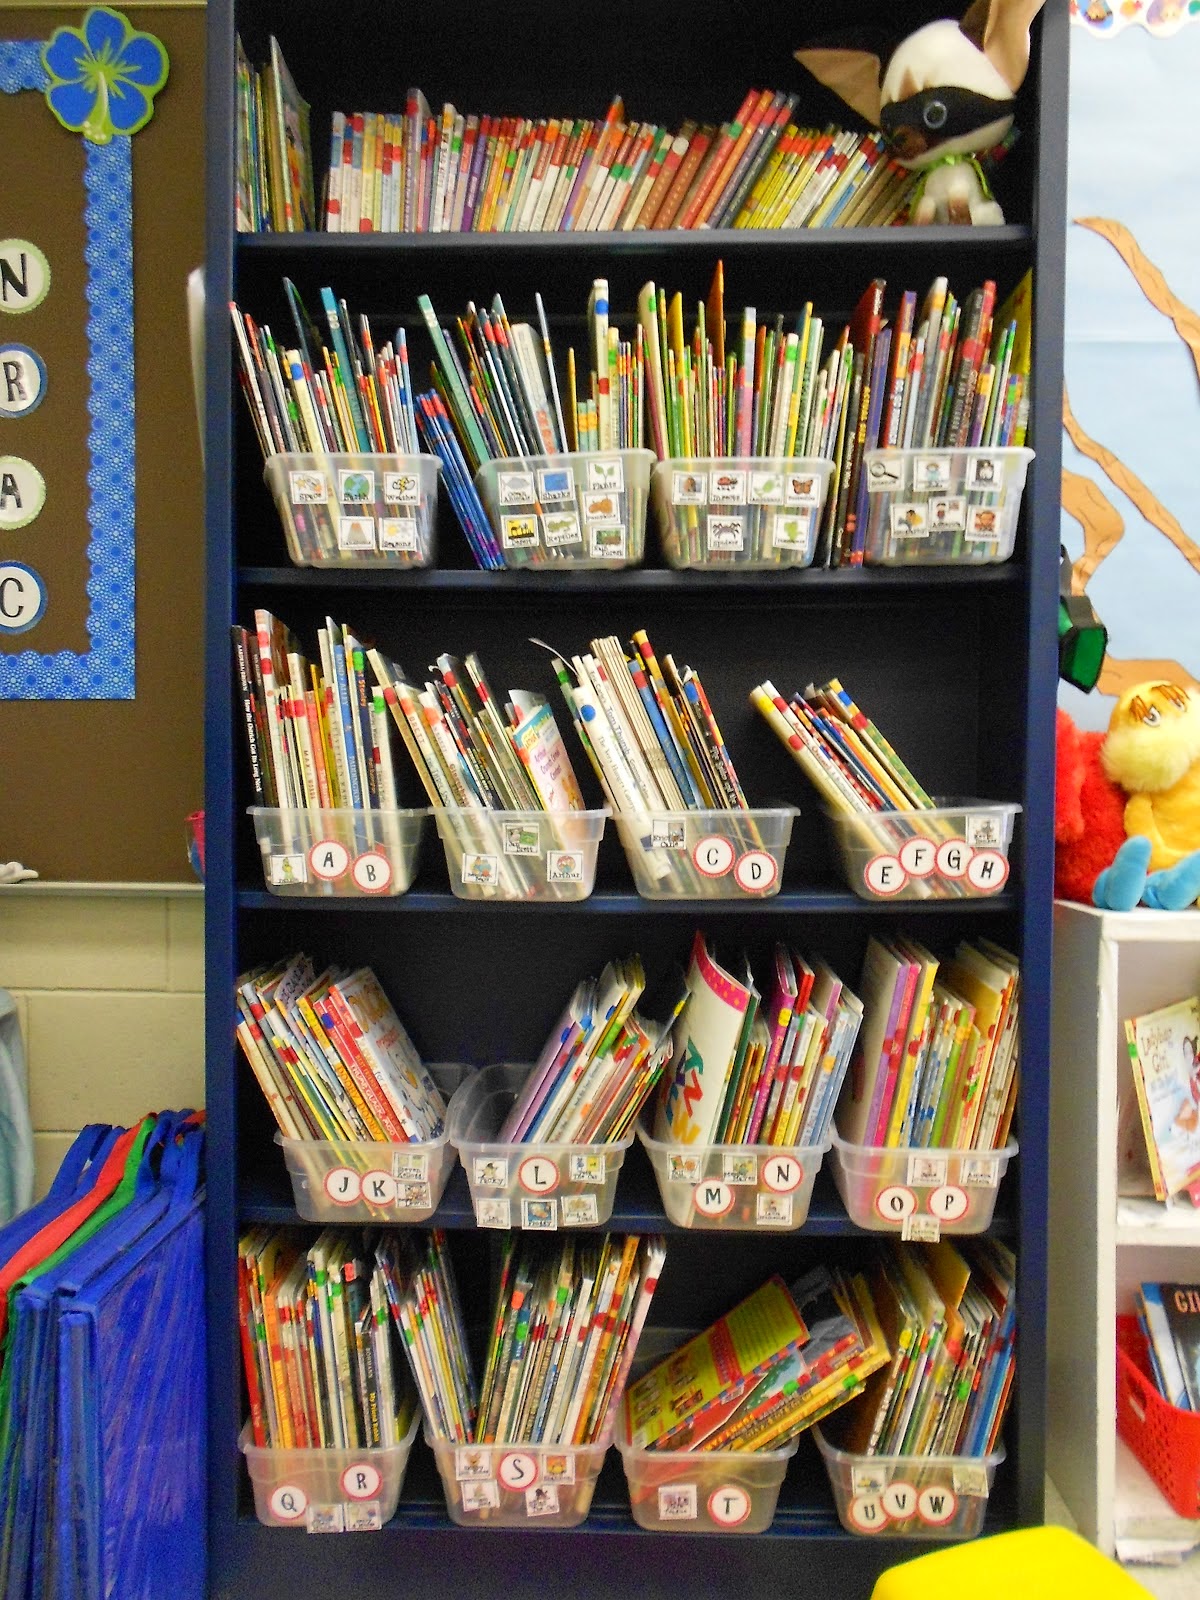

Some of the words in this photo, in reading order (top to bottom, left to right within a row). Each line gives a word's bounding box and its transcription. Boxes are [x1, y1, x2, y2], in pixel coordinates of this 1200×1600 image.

[0, 253, 28, 298] N
[3, 360, 28, 402] R
[1, 473, 24, 510] A
[543, 491, 571, 500] Sharks
[592, 482, 617, 490] Plants
[0, 577, 24, 618] C
[336, 654, 345, 676] BOND
[339, 682, 349, 707] ALLEY
[247, 723, 255, 743] Ostrich
[605, 706, 619, 726] Tom
[613, 725, 633, 756] Thumb
[348, 756, 361, 804] PADDINGTON
[610, 763, 627, 789] Hungry
[323, 851, 334, 868] A
[706, 849, 719, 866] C
[914, 849, 927, 867] F
[947, 849, 962, 872] G
[365, 864, 377, 882] B
[751, 862, 762, 880] D
[881, 866, 893, 884] E
[980, 861, 994, 879] H
[357, 1102, 381, 1136] DOOBY
[364, 1088, 386, 1119] QUACK,
[382, 1117, 397, 1137] MOO
[534, 1165, 547, 1185] L
[777, 1164, 790, 1183] N
[337, 1176, 350, 1194] J
[372, 1179, 386, 1197] K
[705, 1188, 721, 1205] M
[889, 1195, 905, 1212] O
[944, 1194, 955, 1211] P
[512, 1458, 525, 1480] S
[356, 1472, 367, 1490] R
[280, 1493, 298, 1513] Q
[721, 1496, 739, 1516] T
[894, 1493, 907, 1510] V
[929, 1496, 945, 1514] W
[863, 1502, 877, 1521] U
